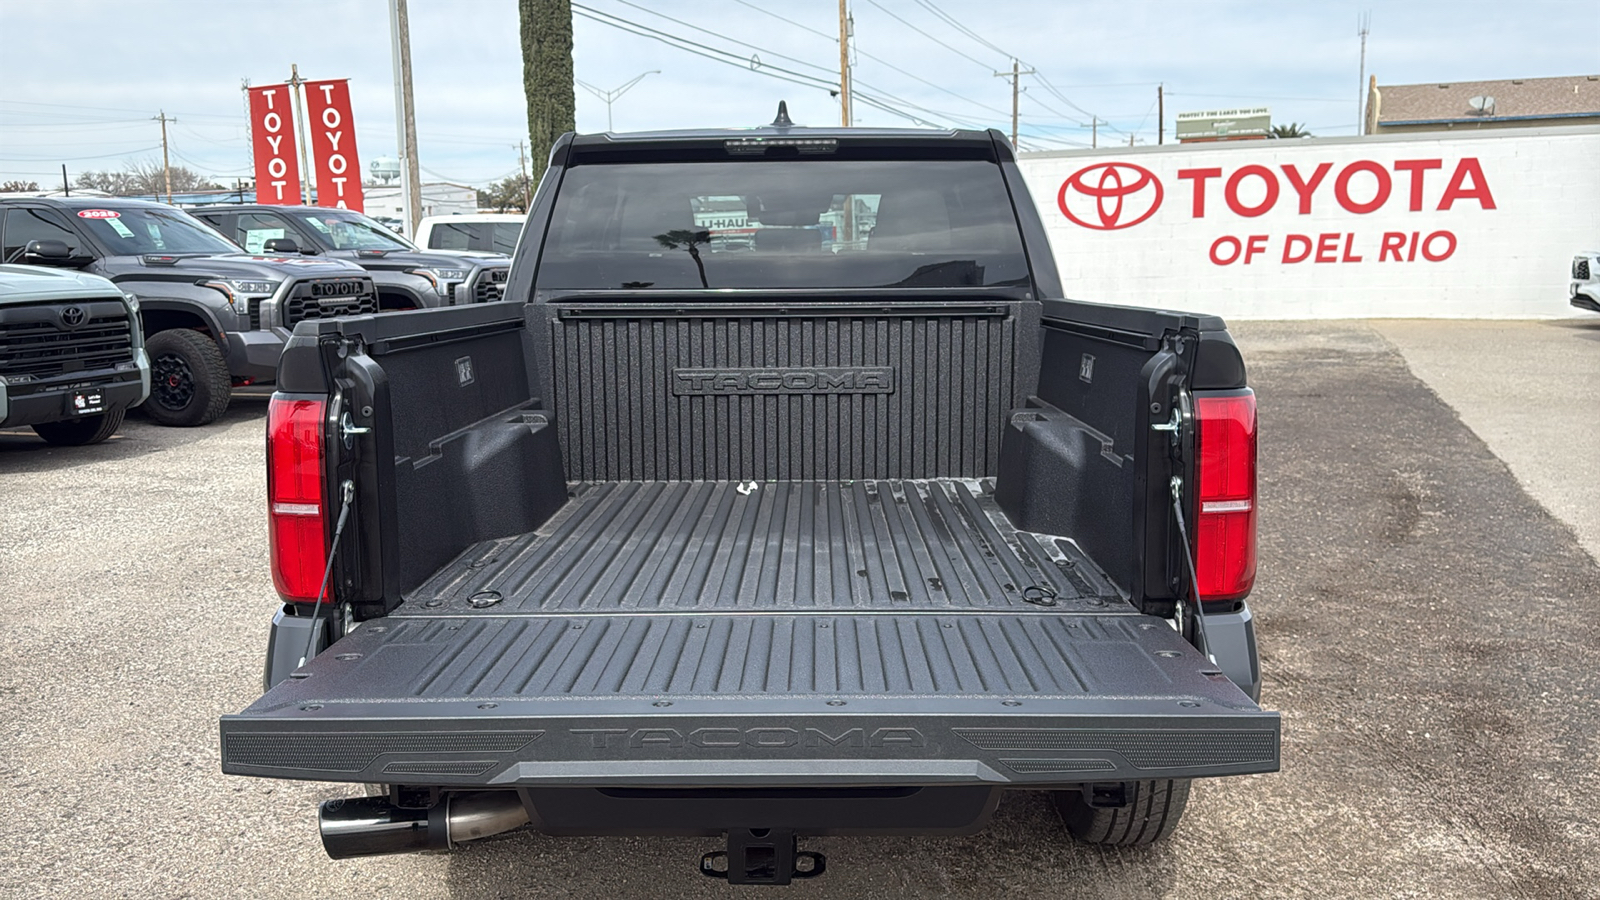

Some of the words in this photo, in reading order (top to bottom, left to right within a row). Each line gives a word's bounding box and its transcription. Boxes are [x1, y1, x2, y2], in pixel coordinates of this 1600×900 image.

[262, 89, 287, 200] TOYOT
[1178, 158, 1496, 218] TOYOTA
[701, 219, 753, 228] U-HAUL
[1209, 235, 1268, 265] OF
[1282, 233, 1362, 263] DEL
[1379, 230, 1456, 261] RIO
[320, 282, 361, 295] TOYOTA
[677, 371, 890, 391] TACOMA
[568, 727, 925, 749] TACOMA
